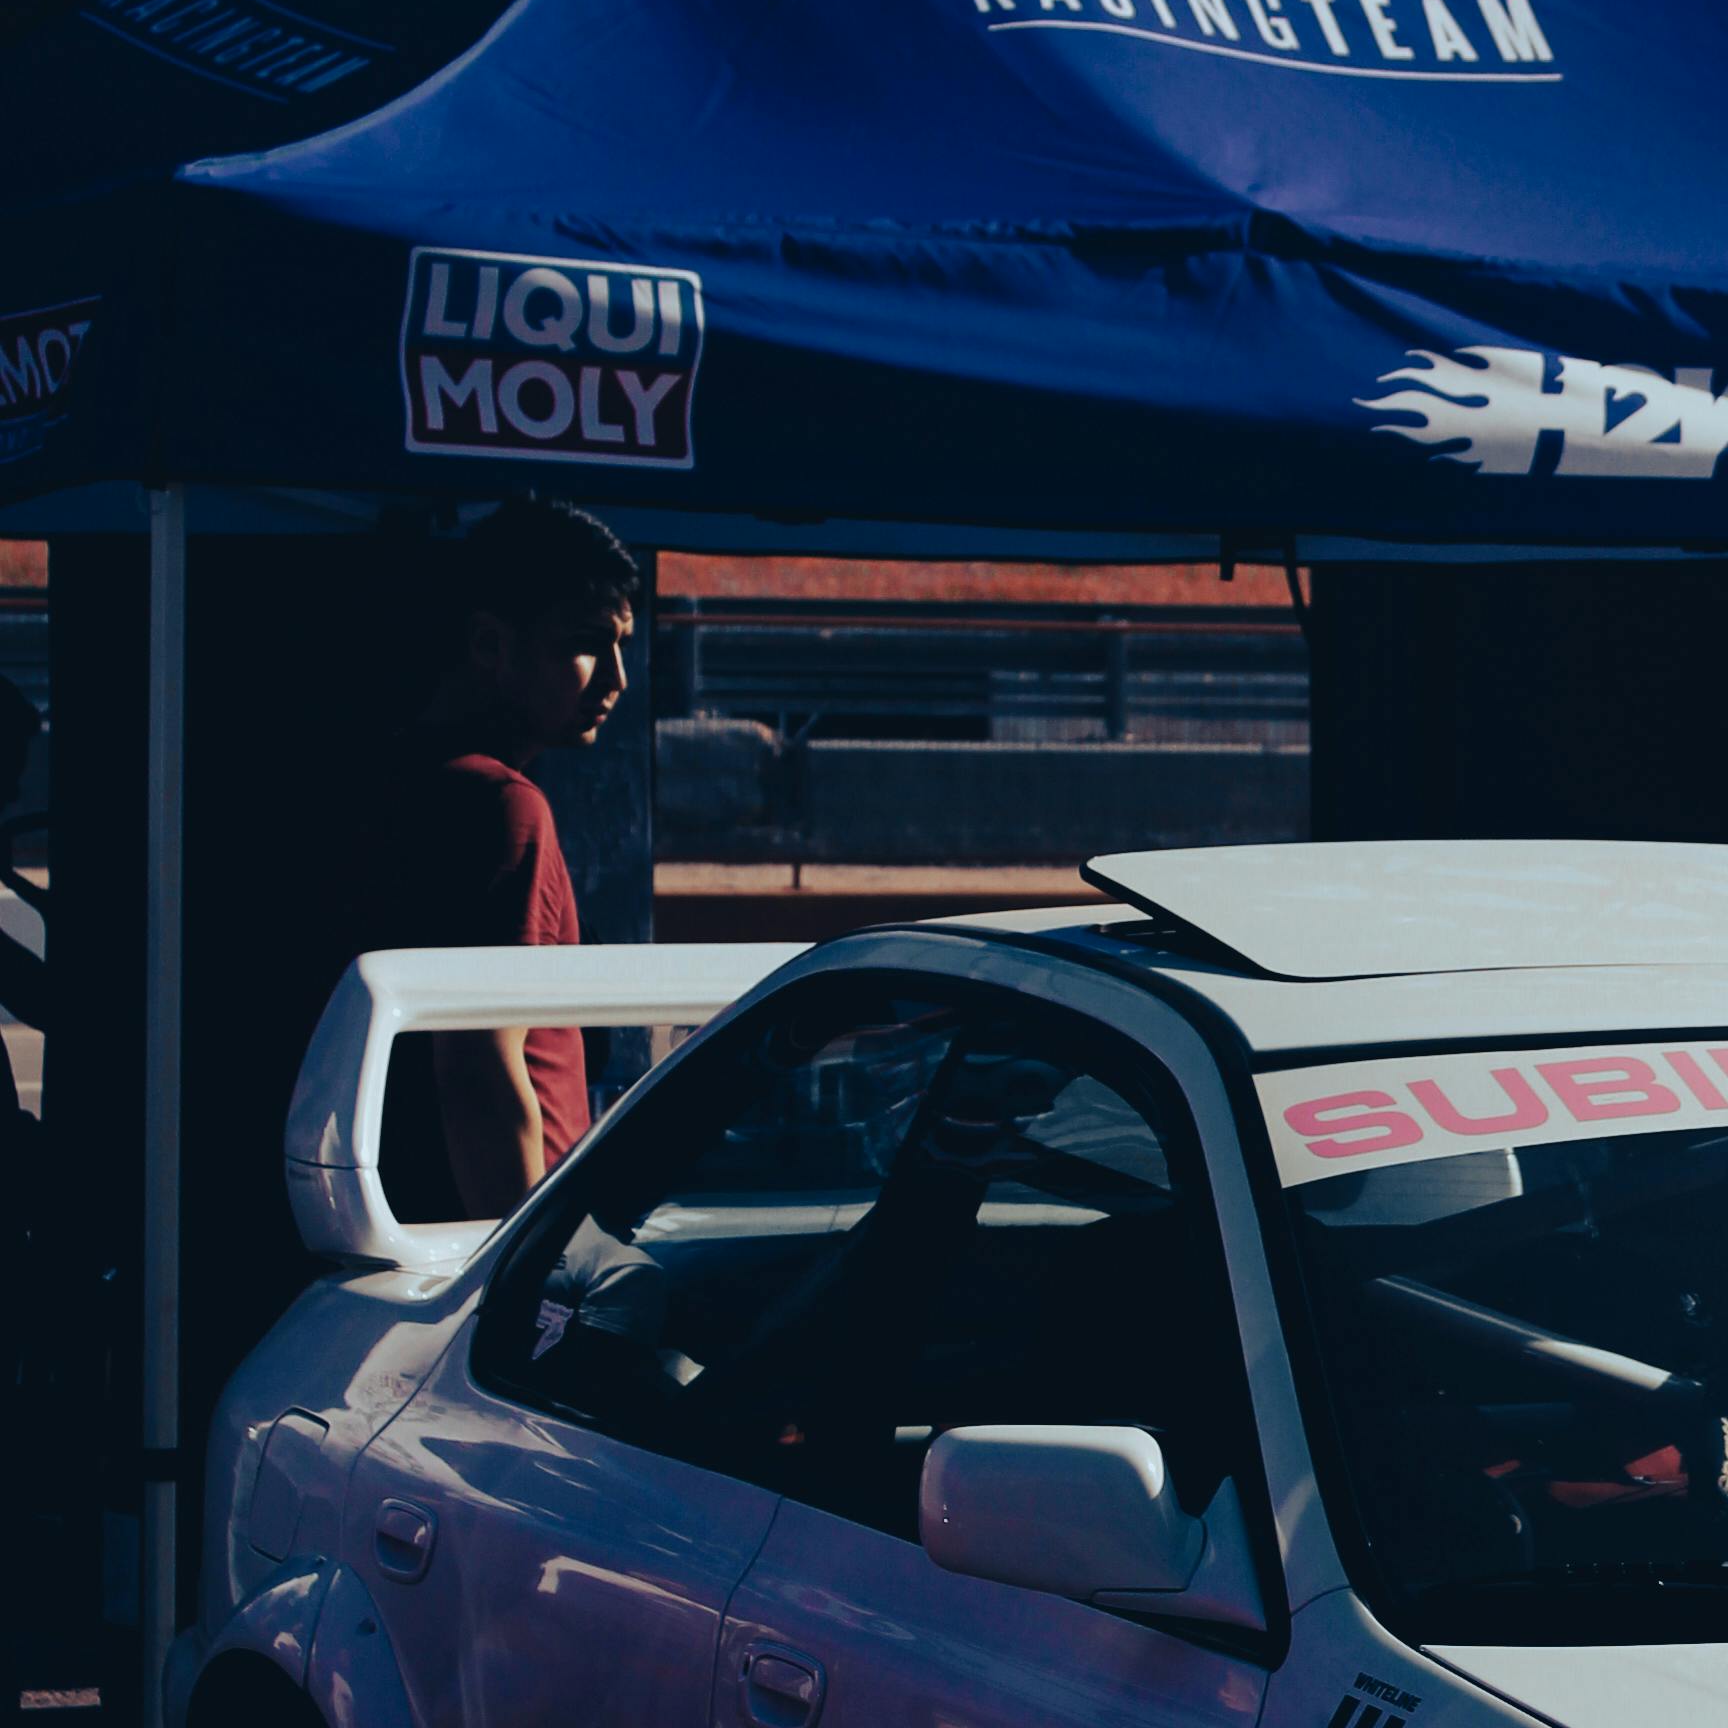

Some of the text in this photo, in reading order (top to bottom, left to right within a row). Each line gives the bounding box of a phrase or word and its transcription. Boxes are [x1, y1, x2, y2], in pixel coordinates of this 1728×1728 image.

[419, 260, 684, 359] LIQUI
[416, 353, 684, 448] MOLY
[1354, 1672, 1422, 1712] WHITELINE
